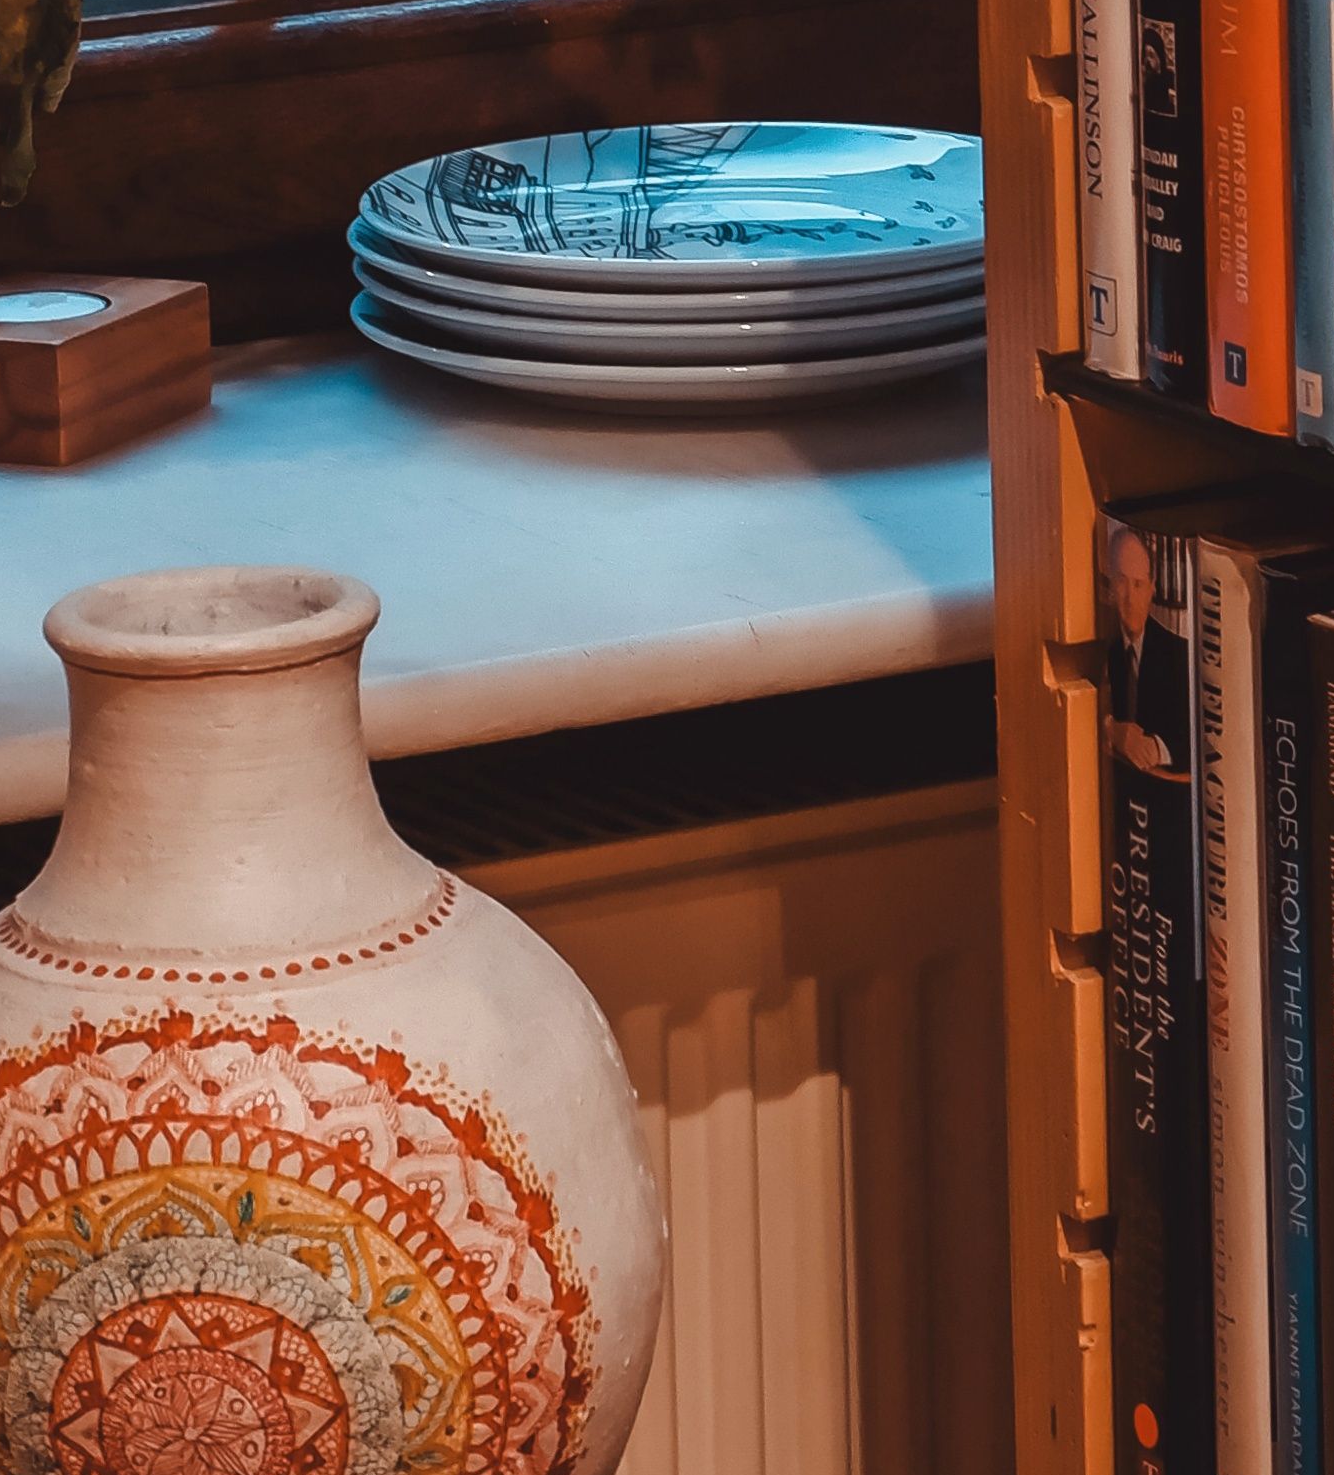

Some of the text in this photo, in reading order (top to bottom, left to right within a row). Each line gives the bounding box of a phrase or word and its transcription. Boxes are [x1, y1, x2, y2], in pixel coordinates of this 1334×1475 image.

[1275, 719, 1308, 1238] ECHOES FROM THE DEAD ZONE
